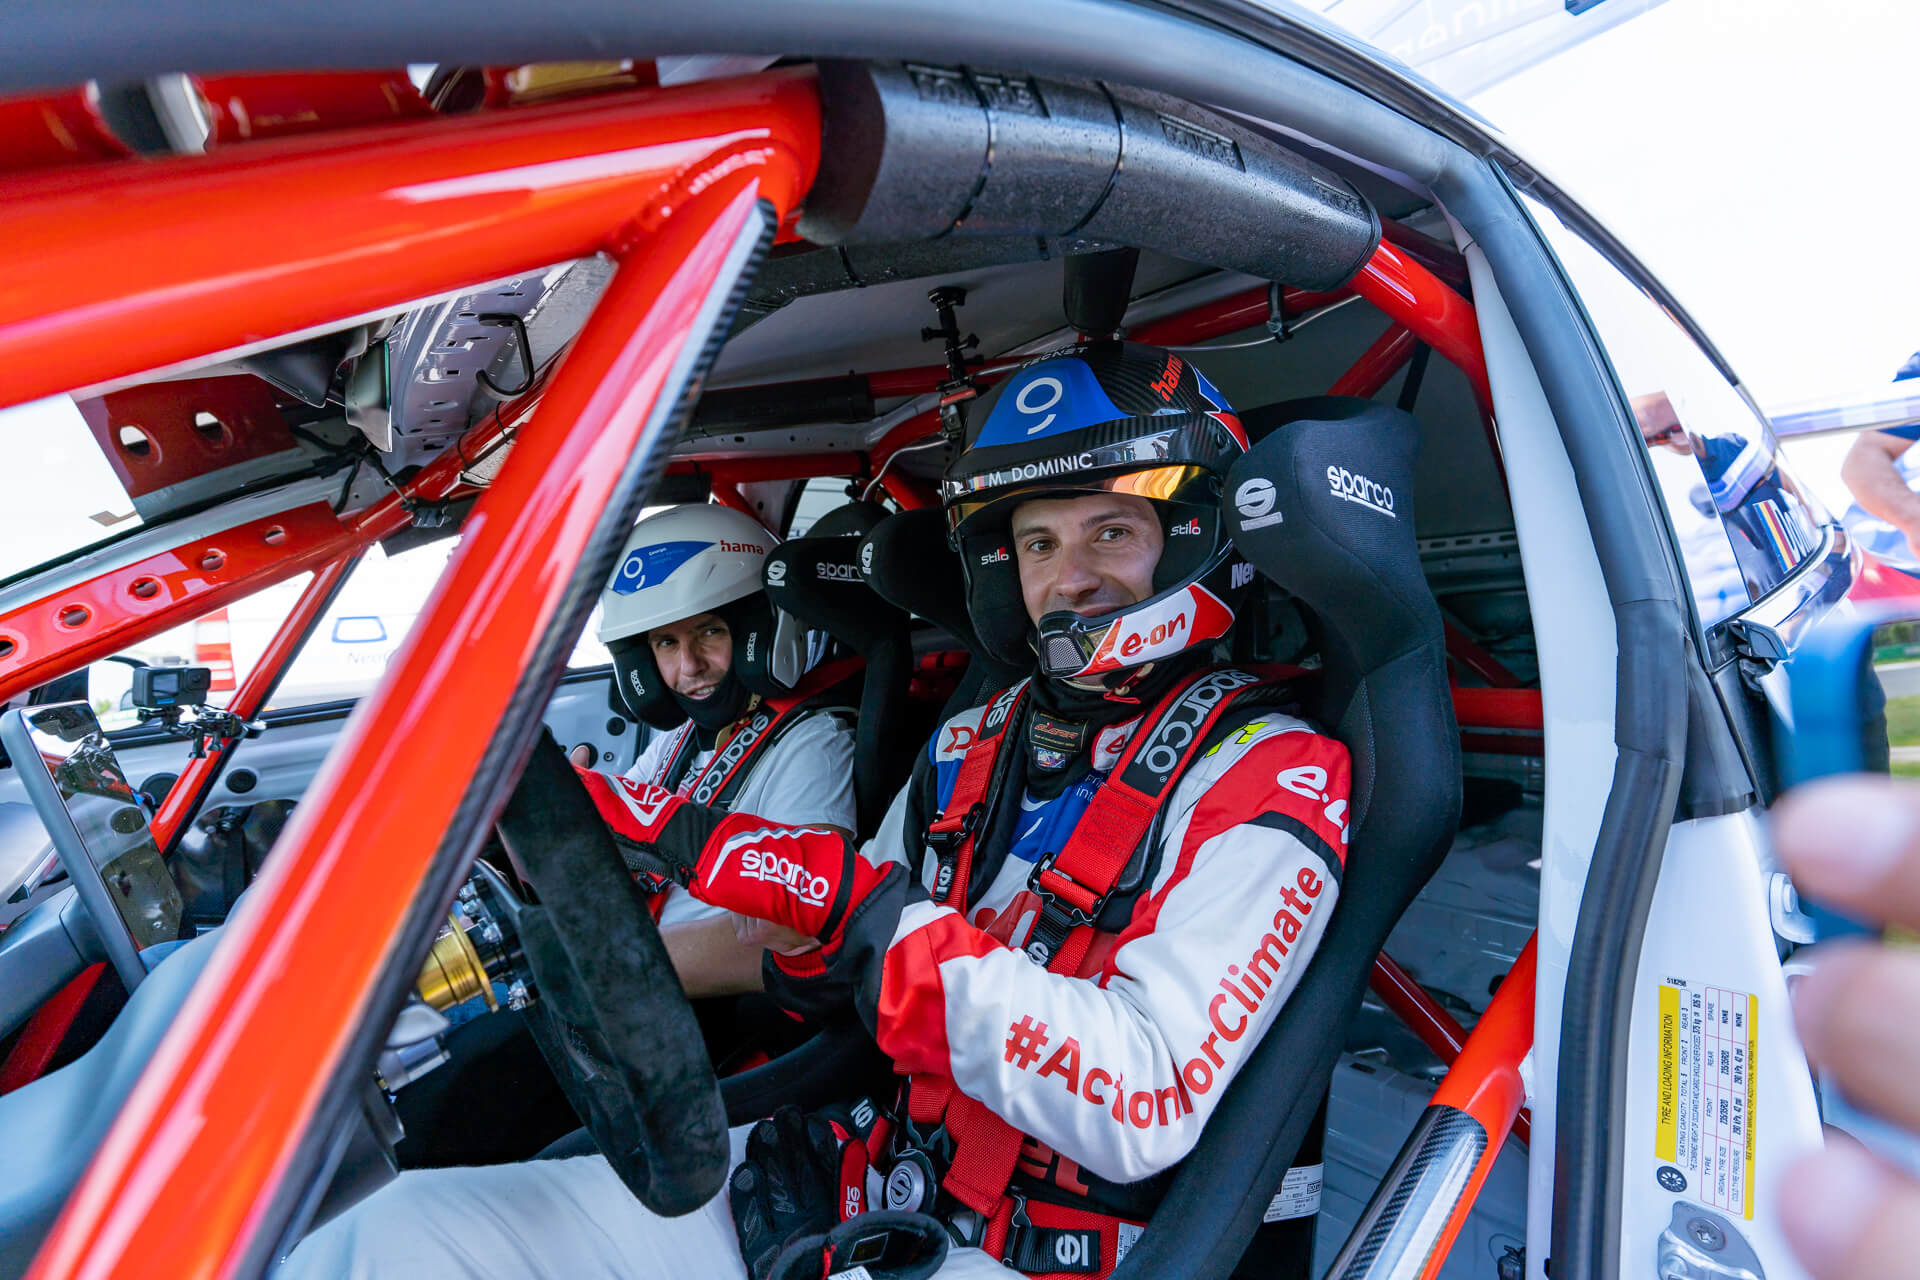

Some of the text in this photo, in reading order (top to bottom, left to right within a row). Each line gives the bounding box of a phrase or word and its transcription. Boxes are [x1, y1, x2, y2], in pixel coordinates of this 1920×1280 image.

[988, 453, 1093, 488] M. DOMINIC
[1327, 465, 1396, 517] sparco
[1170, 518, 1201, 537] stilo
[720, 540, 765, 555] hama
[981, 547, 1010, 565] stilo
[816, 561, 866, 582] spar
[747, 632, 757, 662] sparco
[630, 669, 645, 696] sparco
[1135, 669, 1260, 774] sparco
[692, 711, 769, 803] sparco
[740, 849, 830, 905] sparco
[1721, 1009, 1729, 1024] NONE
[1661, 1013, 1673, 1126] TYRE AND LOADING INFORMATION
[1679, 1130, 1687, 1157] SEATING
